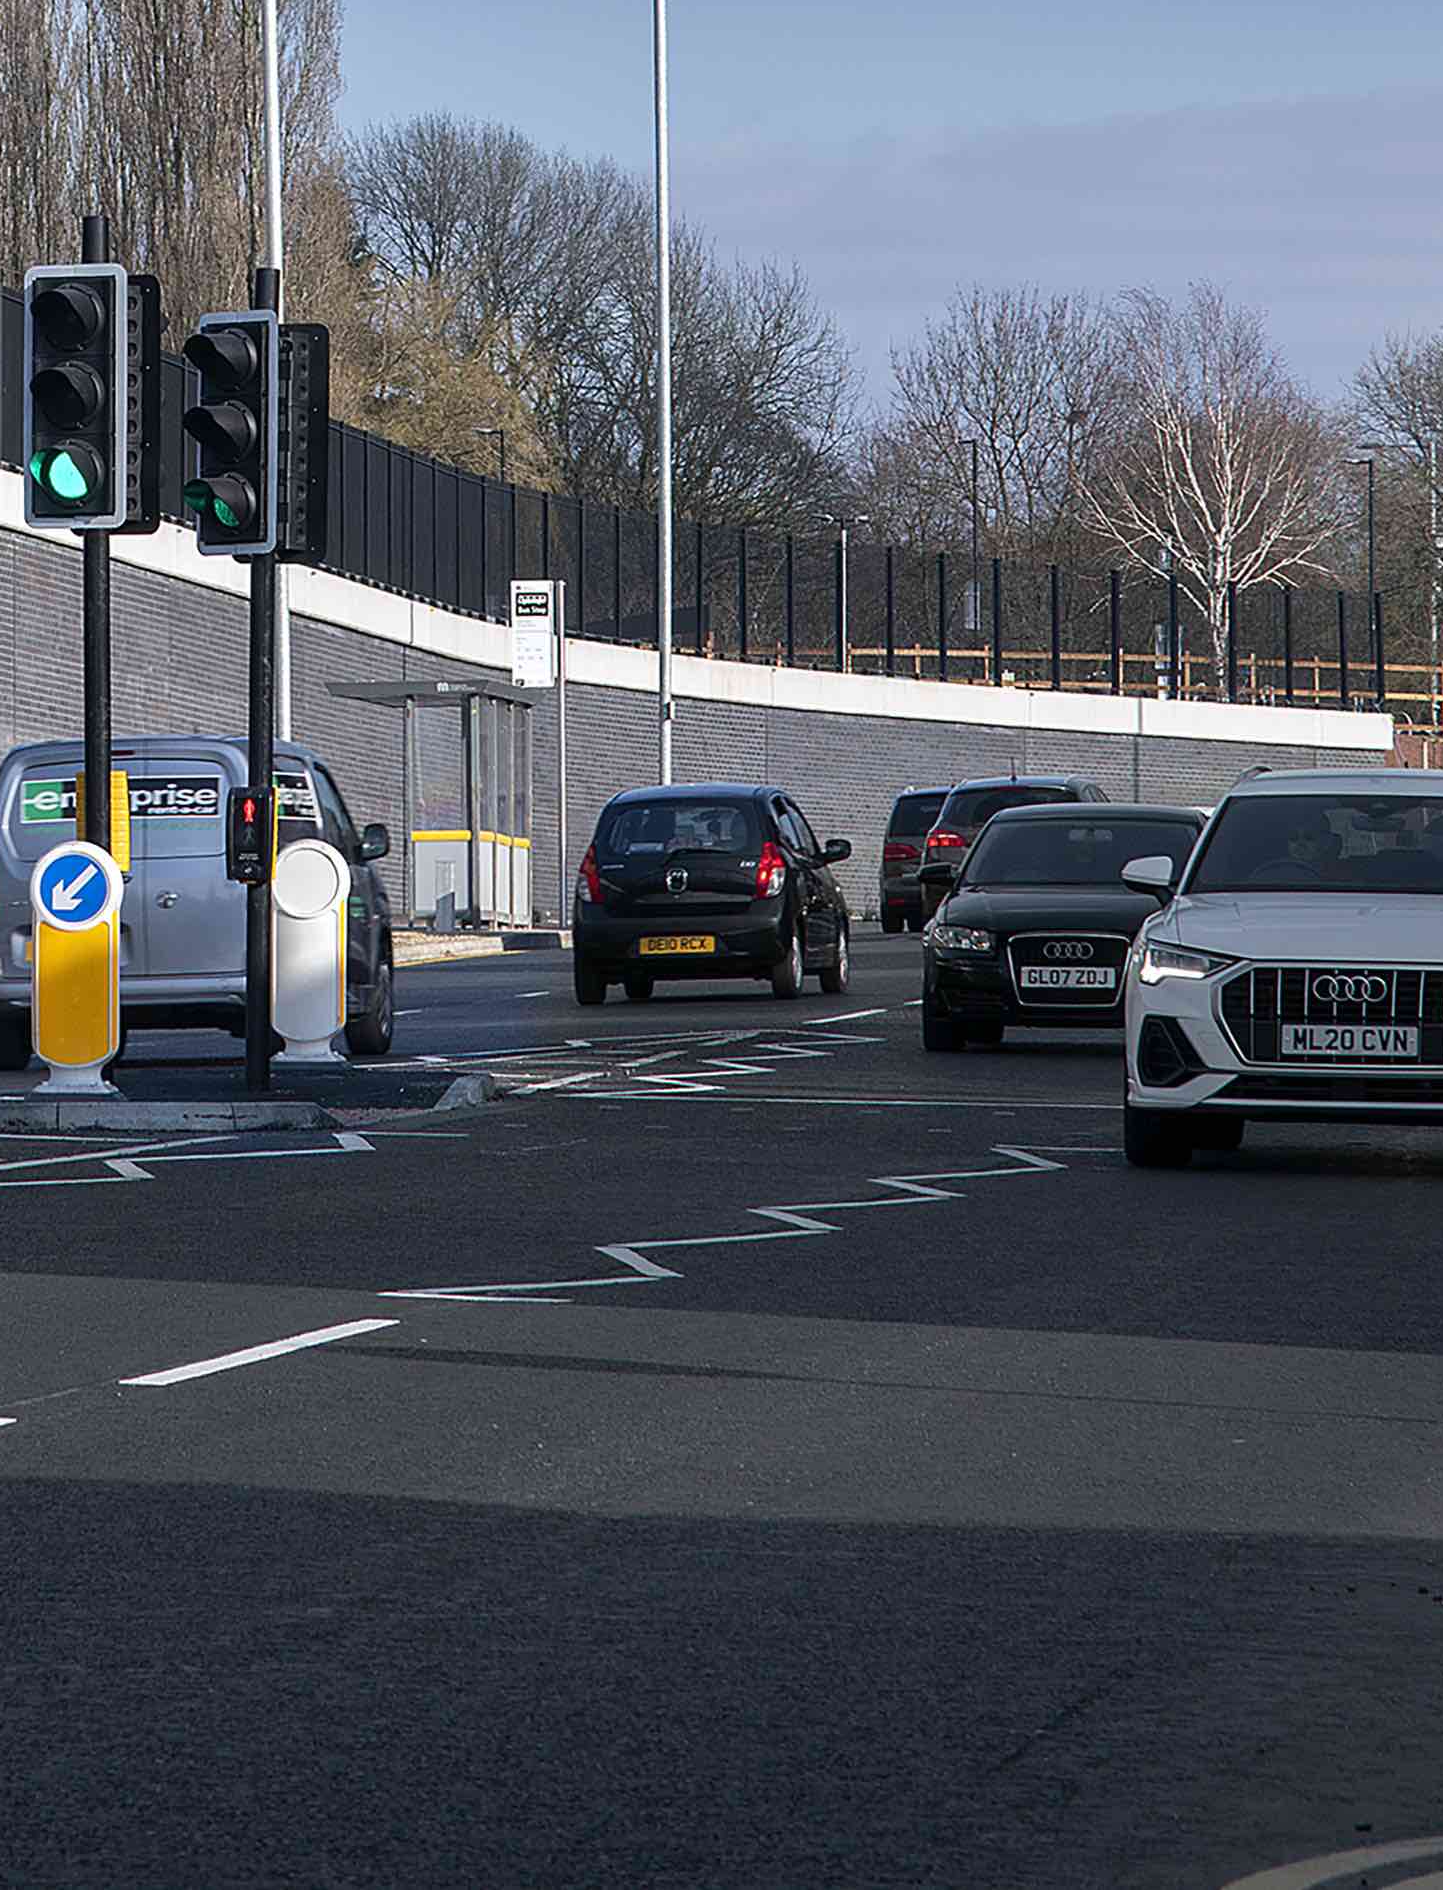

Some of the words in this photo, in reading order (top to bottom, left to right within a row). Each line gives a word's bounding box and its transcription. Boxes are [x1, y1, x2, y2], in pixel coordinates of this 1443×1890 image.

[647, 939, 677, 951] DE10
[680, 938, 707, 950] RCX
[1028, 969, 1071, 985] GL07
[1075, 970, 1108, 985] ZDJ
[1292, 1027, 1355, 1051] ML20
[1362, 1029, 1408, 1052] CVN
